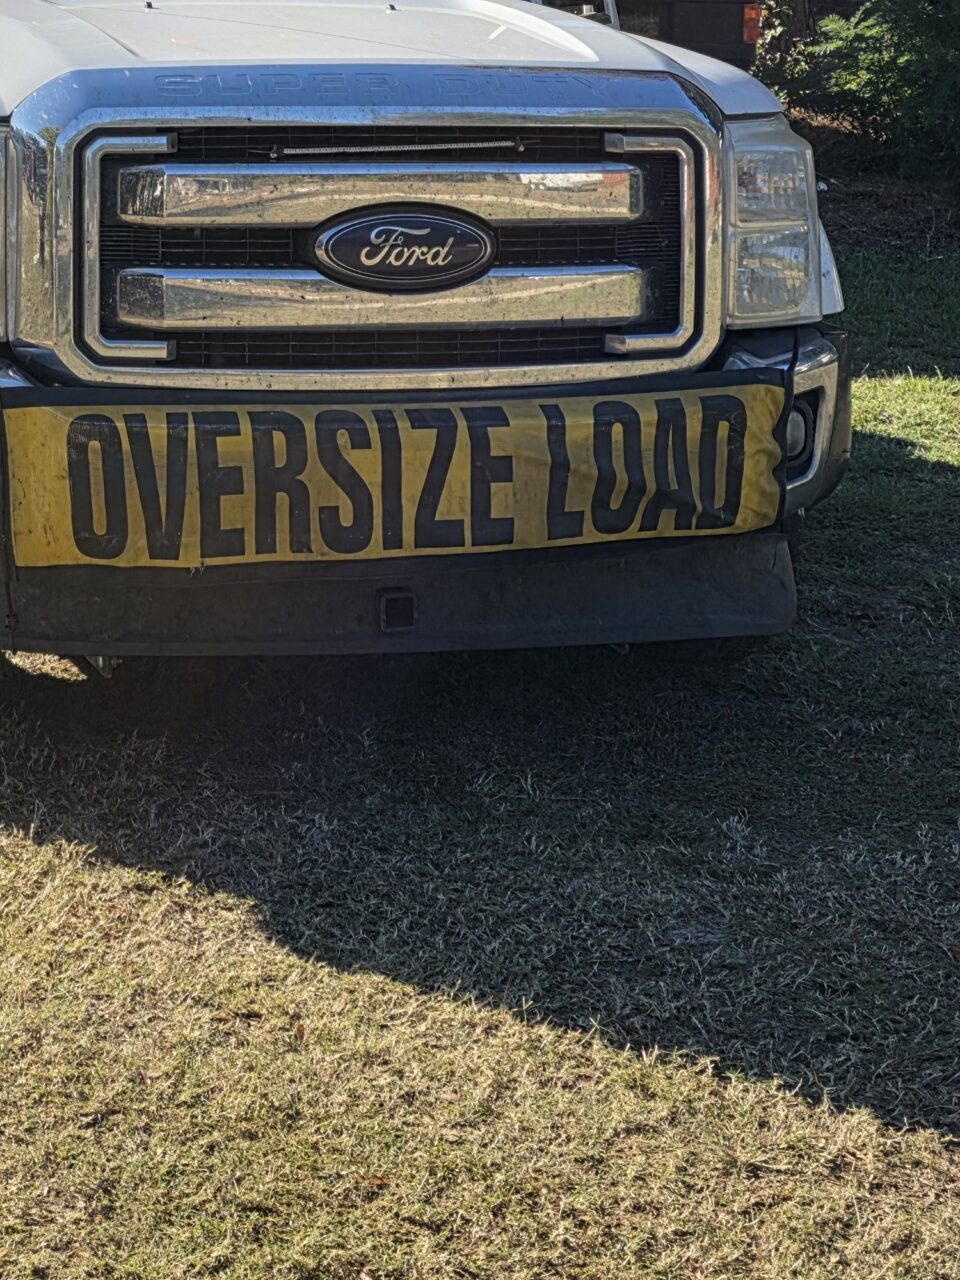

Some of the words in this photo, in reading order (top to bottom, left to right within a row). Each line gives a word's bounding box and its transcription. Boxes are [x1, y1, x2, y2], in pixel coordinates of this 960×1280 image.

[154, 73, 401, 97] SUPER
[360, 226, 454, 266] Ford
[67, 405, 514, 560] OVERSIZE
[540, 395, 748, 541] LOAD
